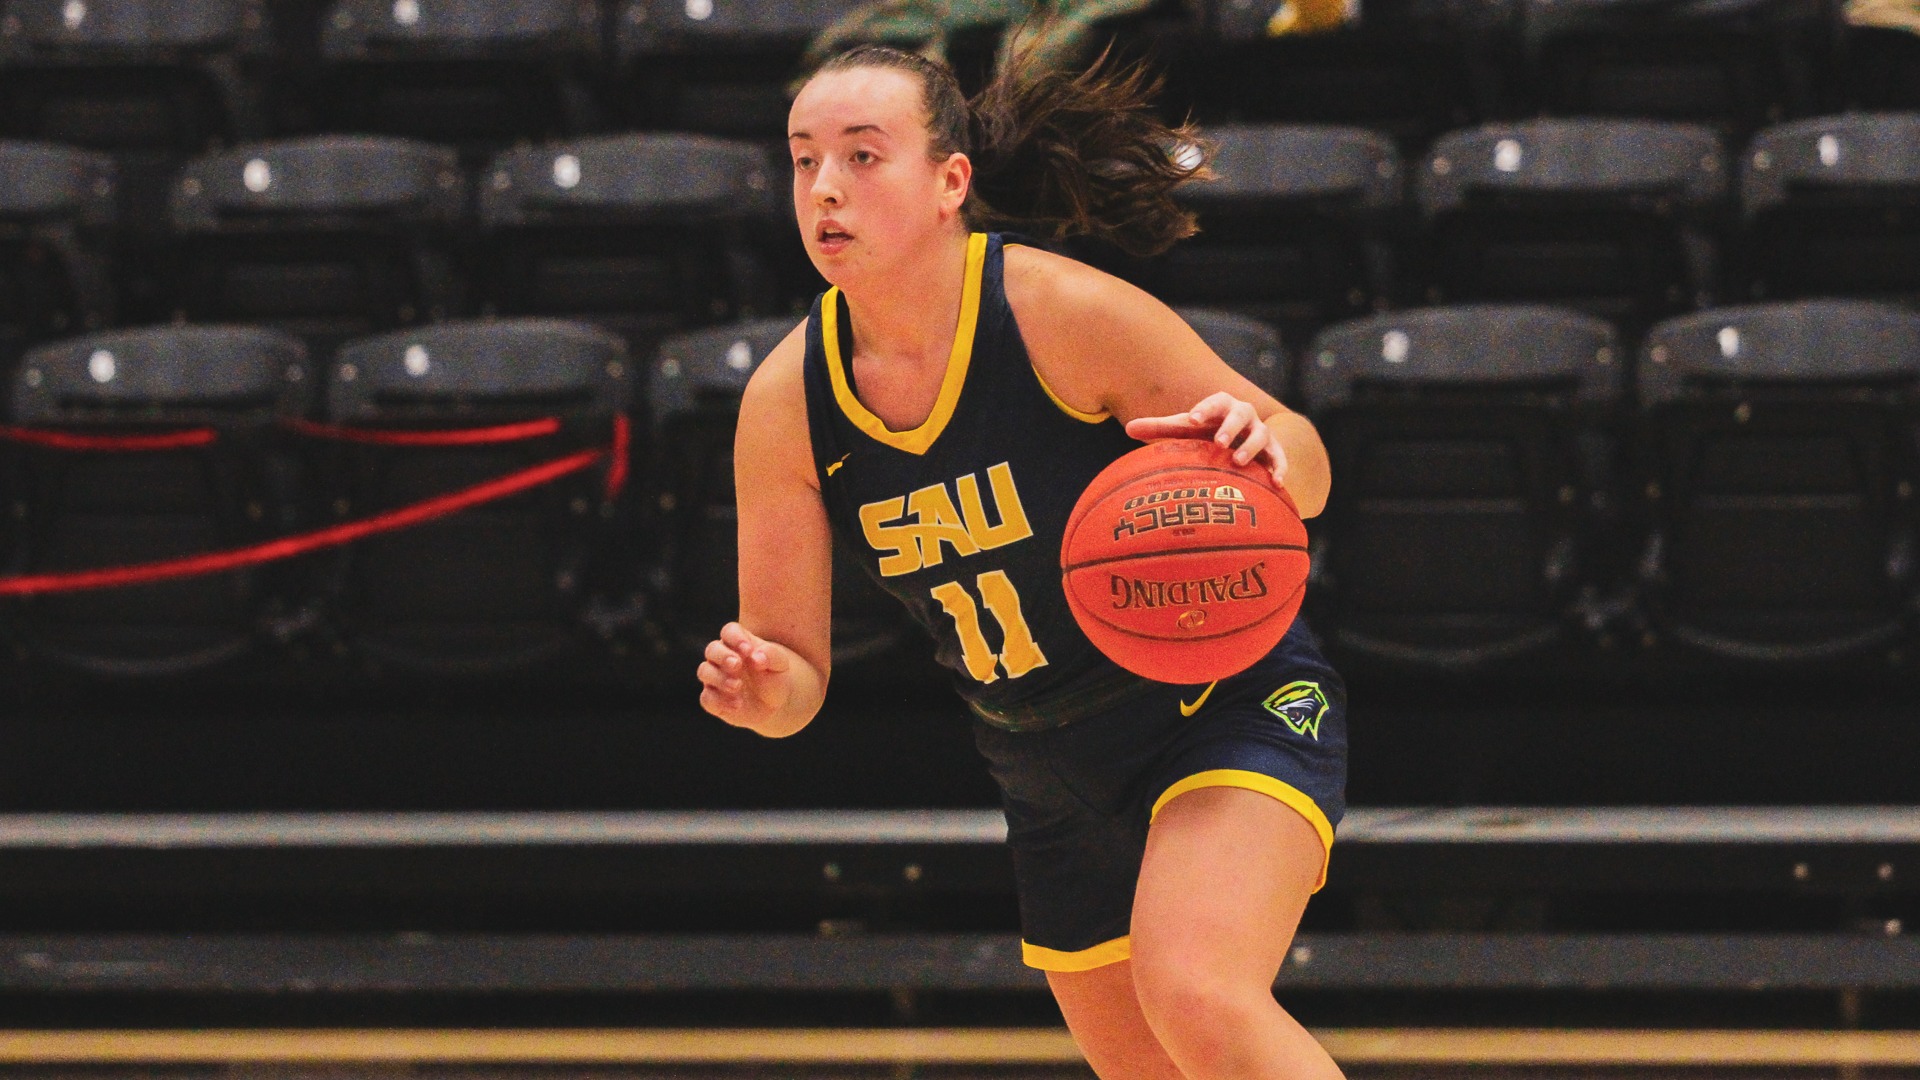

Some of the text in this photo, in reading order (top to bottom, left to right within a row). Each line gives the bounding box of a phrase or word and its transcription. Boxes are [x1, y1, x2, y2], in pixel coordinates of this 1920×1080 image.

[859, 462, 1034, 576] SAU
[1113, 502, 1257, 541] LEGACY
[1123, 487, 1210, 511] 1000
[1111, 561, 1268, 610] SPALDING
[930, 569, 1049, 684] 11
